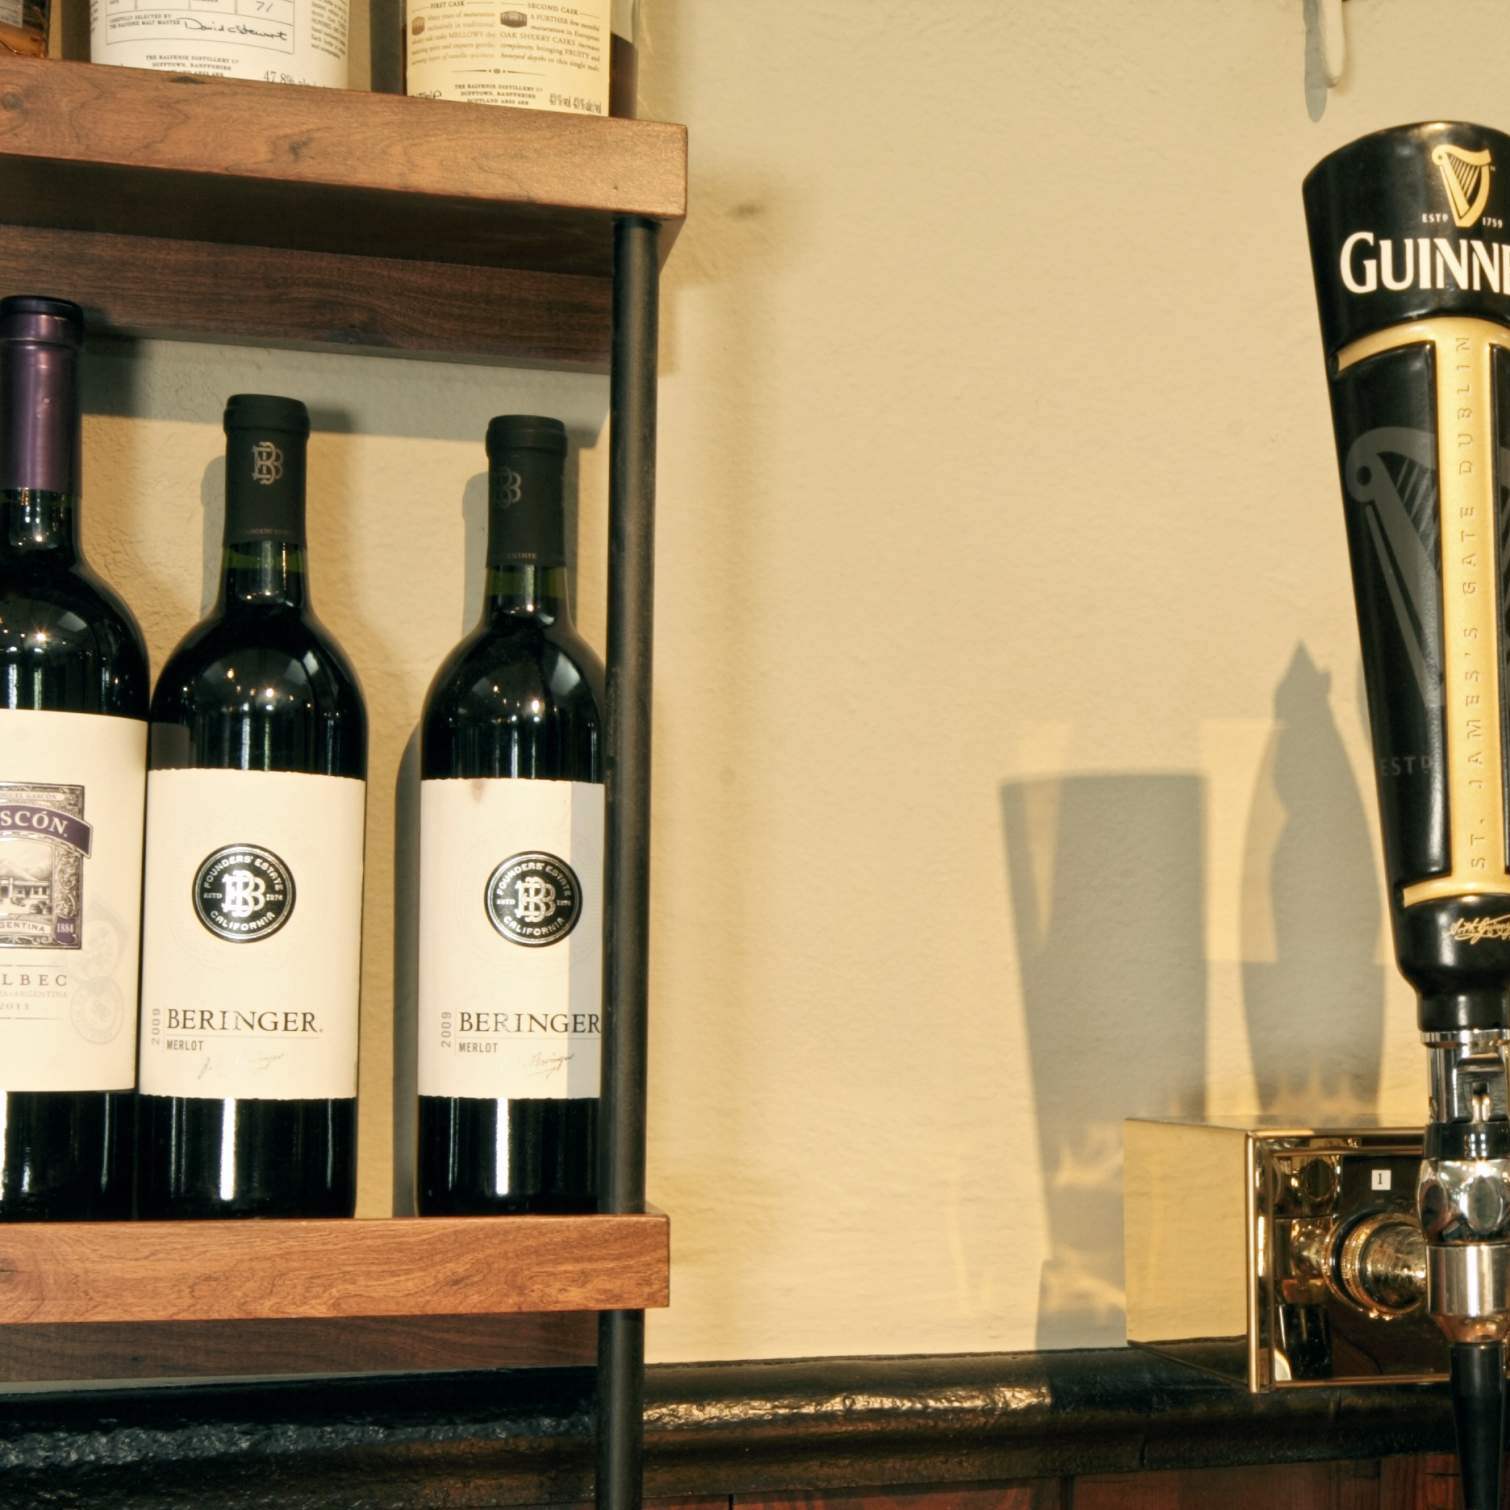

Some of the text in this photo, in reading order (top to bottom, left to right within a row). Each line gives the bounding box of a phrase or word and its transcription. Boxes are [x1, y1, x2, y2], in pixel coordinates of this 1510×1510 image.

[1482, 216, 1503, 228] 1759
[1455, 336, 1474, 476] DUBLIN
[1459, 505, 1478, 595] GATE
[210, 909, 276, 932] CALIFORNIA
[503, 915, 565, 937] CALIFORNIA
[440, 1010, 453, 1048] 2009
[458, 1010, 601, 1034] BERINGER
[165, 1039, 205, 1052] MERLOT
[458, 1041, 499, 1054] MERLOT
